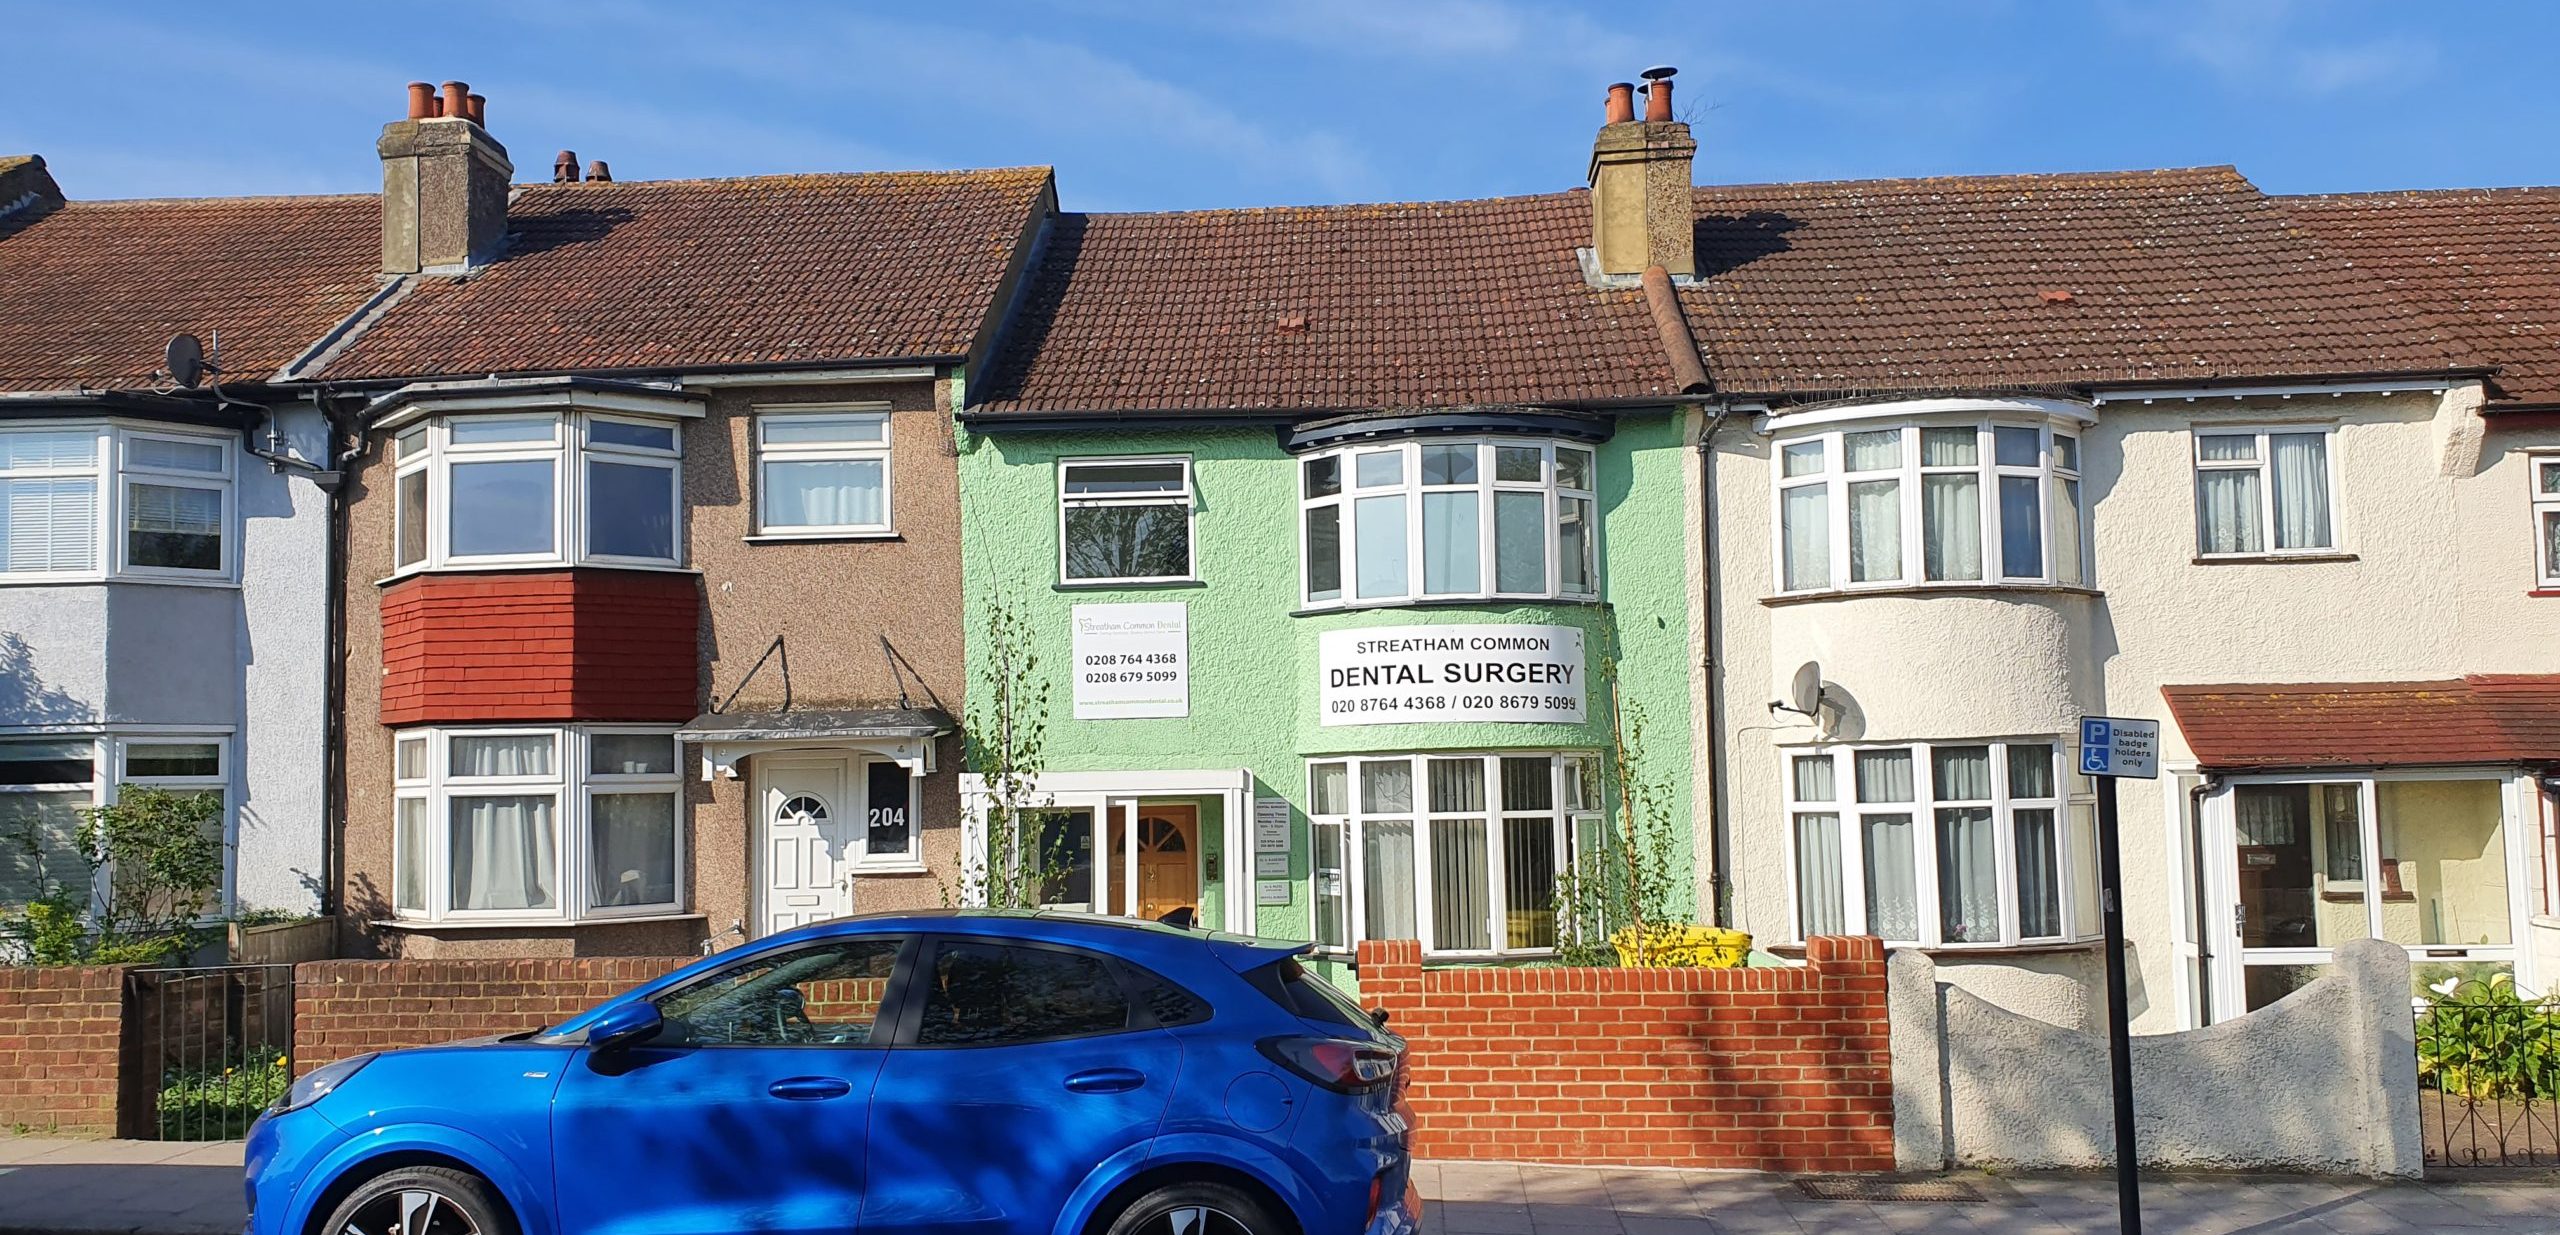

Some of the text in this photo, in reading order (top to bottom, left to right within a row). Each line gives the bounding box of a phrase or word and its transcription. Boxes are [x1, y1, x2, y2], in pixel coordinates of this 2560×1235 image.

[1084, 620, 1182, 631] Streatham Common Dental
[1357, 637, 1550, 654] STREATHAM COMMON
[1085, 653, 1177, 666] 0208 764 4368
[1086, 671, 1177, 683] 0208 679 5099
[1331, 662, 1575, 688] DENTAL SURGERY
[1331, 695, 1577, 713] 020 8764 4368 / 020 8679 5099
[2090, 723, 2106, 742] P
[2113, 728, 2155, 738] Disabled
[2118, 739, 2148, 748] badge
[2115, 748, 2151, 757] holders
[2122, 758, 2143, 767] only
[869, 807, 905, 827] 204
